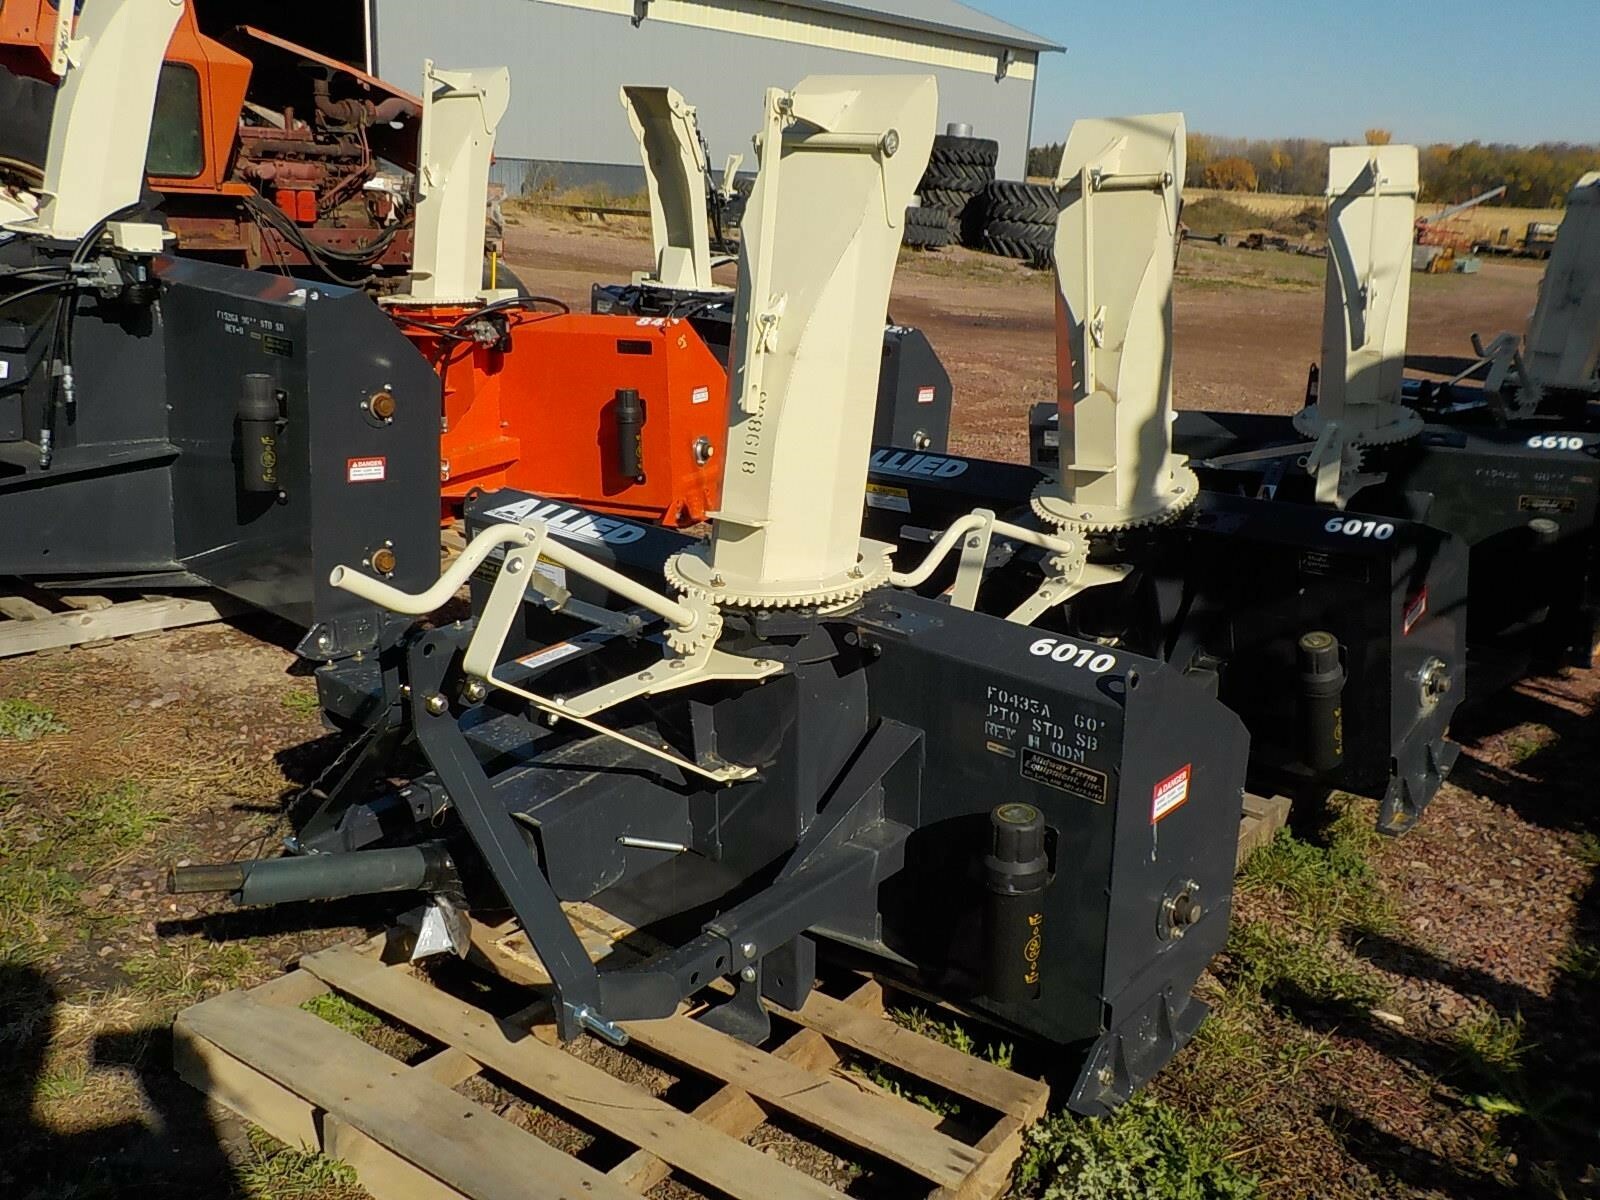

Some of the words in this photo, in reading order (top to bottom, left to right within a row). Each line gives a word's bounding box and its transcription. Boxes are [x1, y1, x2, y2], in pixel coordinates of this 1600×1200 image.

[1527, 435, 1584, 450] 6610
[870, 449, 969, 478] LLIED
[483, 498, 646, 545] ALLIED
[1324, 517, 1395, 540] 6010
[1029, 638, 1116, 673] 6010
[1032, 718, 1064, 740] STD
[1076, 733, 1098, 751] SB
[1032, 754, 1069, 772] Midway
[1070, 767, 1098, 782] Farm
